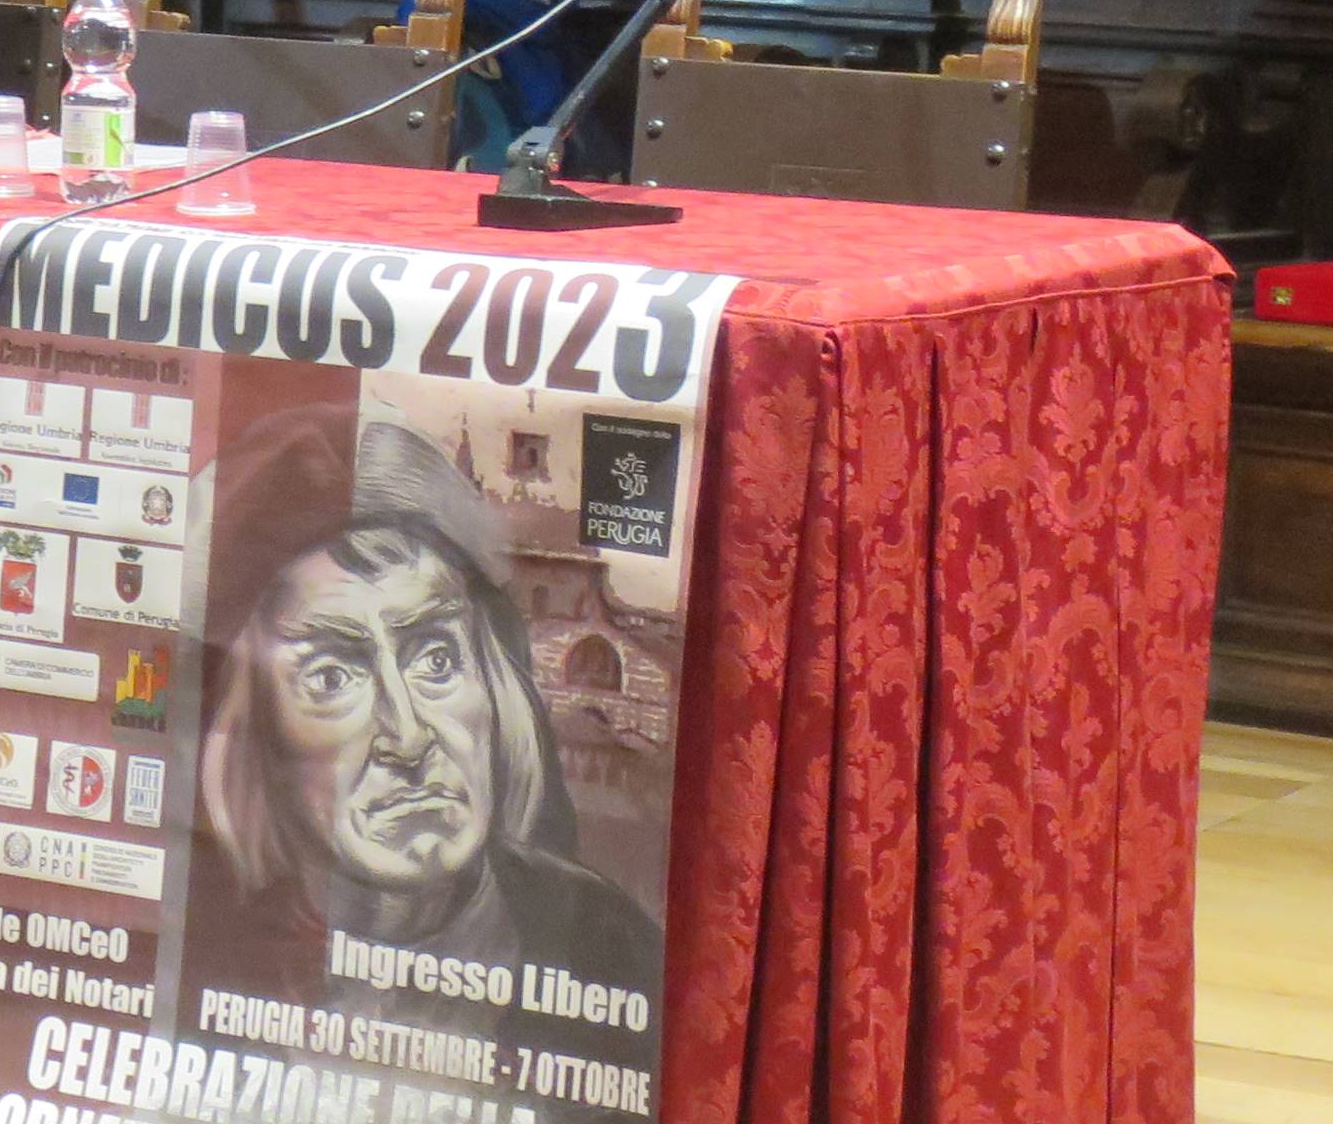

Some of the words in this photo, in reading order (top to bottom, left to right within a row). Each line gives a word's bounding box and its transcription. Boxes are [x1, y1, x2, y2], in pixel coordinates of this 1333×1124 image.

[419, 262, 724, 404] 2023
[37, 423, 83, 442] Umbria
[89, 429, 140, 448] Regione
[143, 435, 191, 454] Umbria
[588, 500, 667, 525] FONDAZIONE
[587, 518, 663, 547] PERUGIA
[73, 602, 122, 620] Comune
[124, 608, 135, 621] di
[137, 611, 180, 629] Perugia
[39, 835, 74, 858] CNA
[38, 857, 73, 879] PPC
[26, 912, 129, 964] OMCeO
[12, 960, 60, 1001] dei
[64, 968, 156, 1019] Notari
[330, 929, 513, 1007] Ingresso
[520, 962, 649, 1033] Libero
[199, 988, 307, 1050] PERUGIA
[309, 1008, 346, 1057] 30
[349, 1015, 498, 1086] SETTEMBRE
[516, 1046, 533, 1092] 7
[534, 1050, 650, 1117] OTTOBRE
[27, 1015, 381, 1124] CELEBRAZIONE
